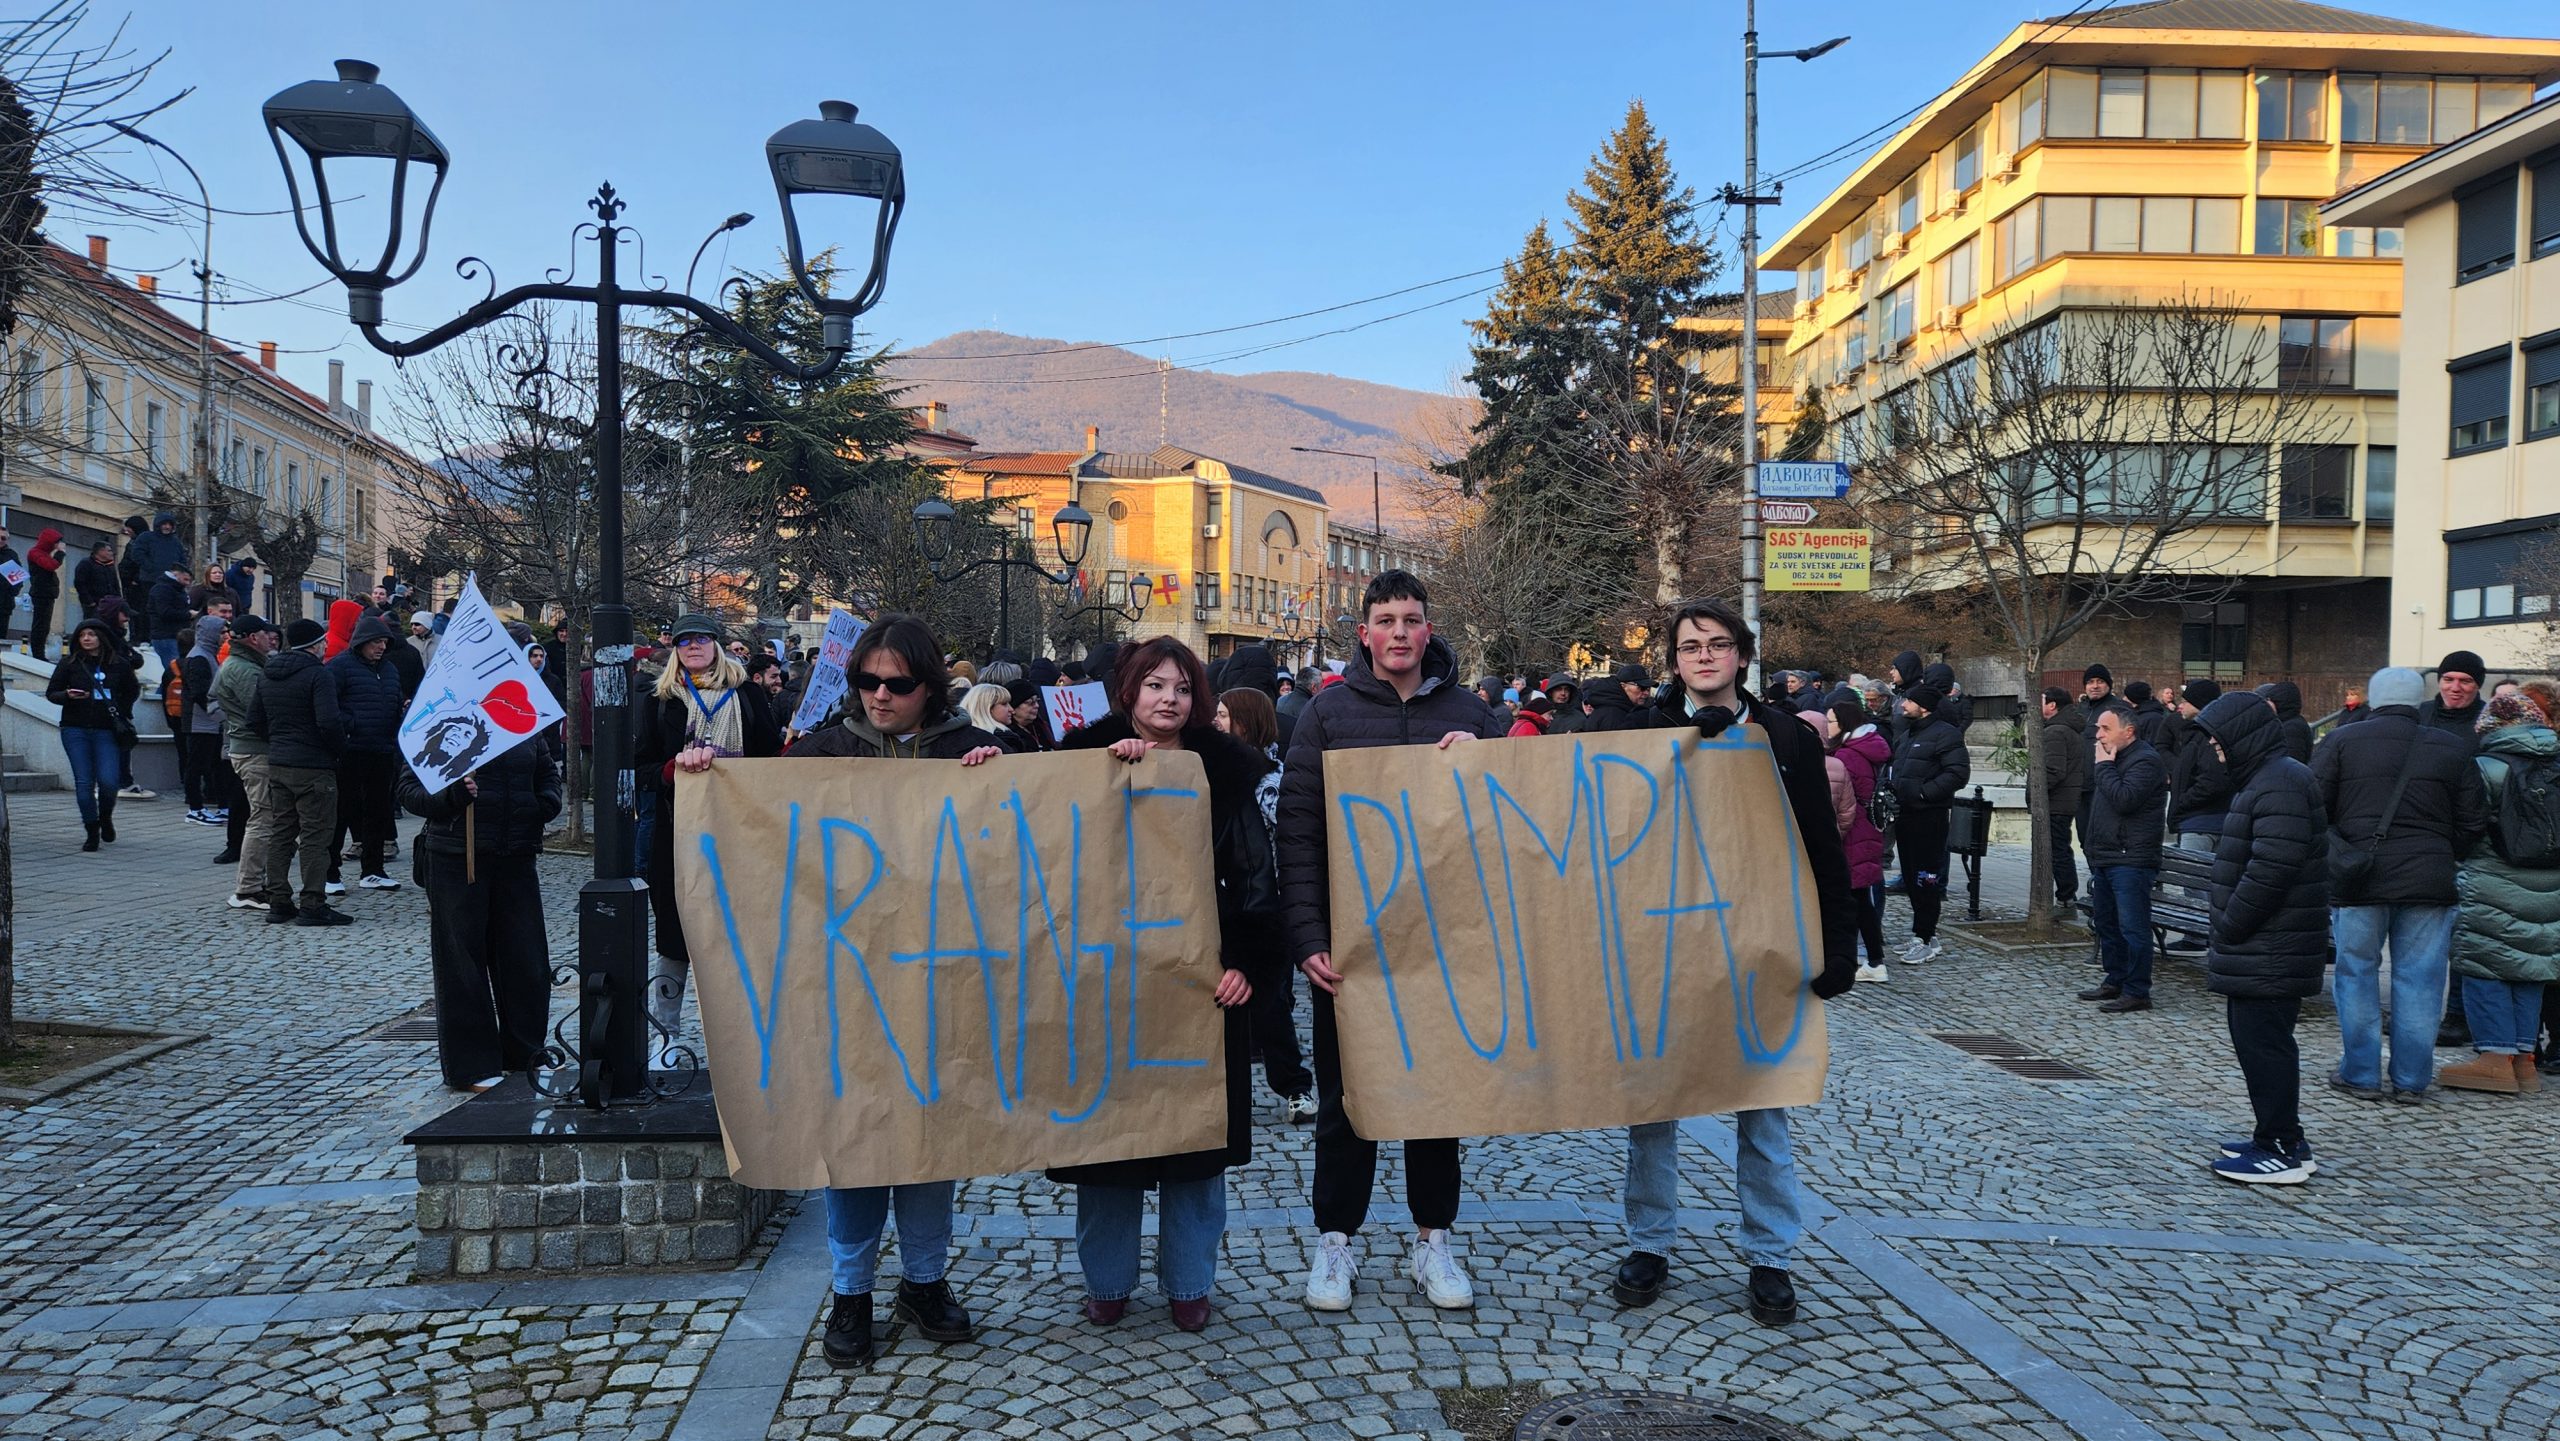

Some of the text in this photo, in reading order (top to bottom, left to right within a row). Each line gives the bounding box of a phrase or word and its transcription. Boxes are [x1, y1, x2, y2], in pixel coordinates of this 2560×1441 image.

[1761, 467, 1834, 484] АДВОКАТ
[1761, 505, 1808, 521] АДВОКАТ
[1803, 531, 1868, 550] Agencija
[1777, 551, 1859, 560] SUDSKI PREVODILAC
[1769, 561, 1866, 570] ZA SVE SVETSKE JEZIKE
[1792, 571, 1843, 579] 062 524 864
[471, 647, 519, 681] IT
[1338, 728, 1812, 1073] PUMPAJ
